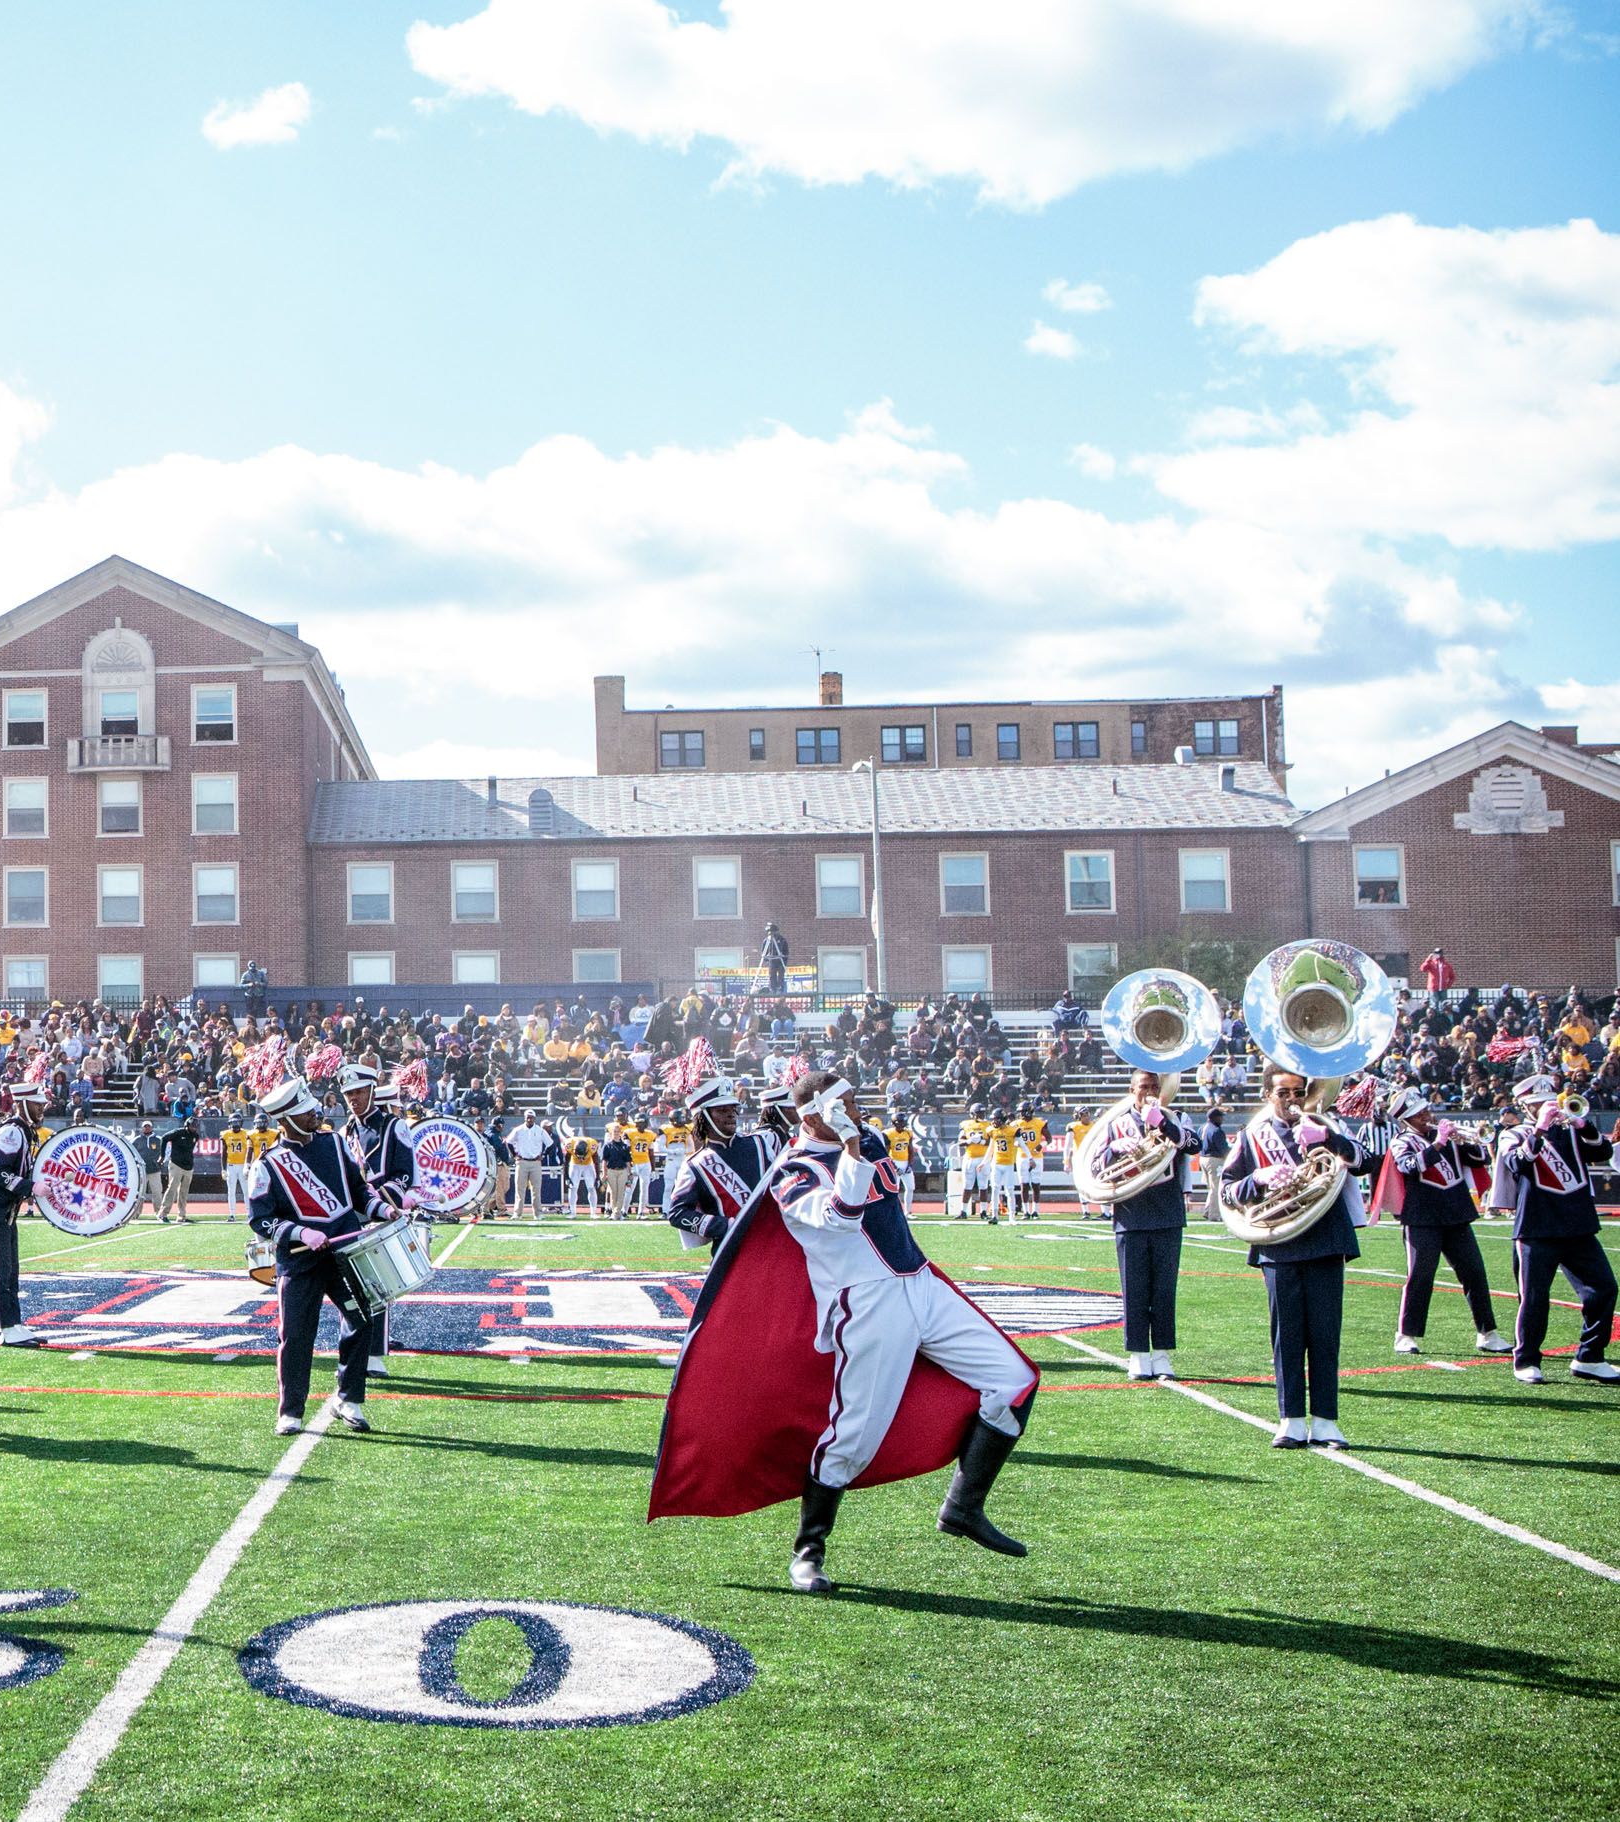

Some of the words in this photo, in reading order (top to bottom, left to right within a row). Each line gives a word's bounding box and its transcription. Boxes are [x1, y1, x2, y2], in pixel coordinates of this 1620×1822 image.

[51, 1132, 90, 1161] HOWARD
[91, 1133, 129, 1187] UNIVERSITY
[231, 1141, 242, 1153] 14
[441, 1123, 479, 1167] UNIVERSITY
[281, 1151, 337, 1212] HOWARD
[703, 1153, 751, 1205] HOWAR
